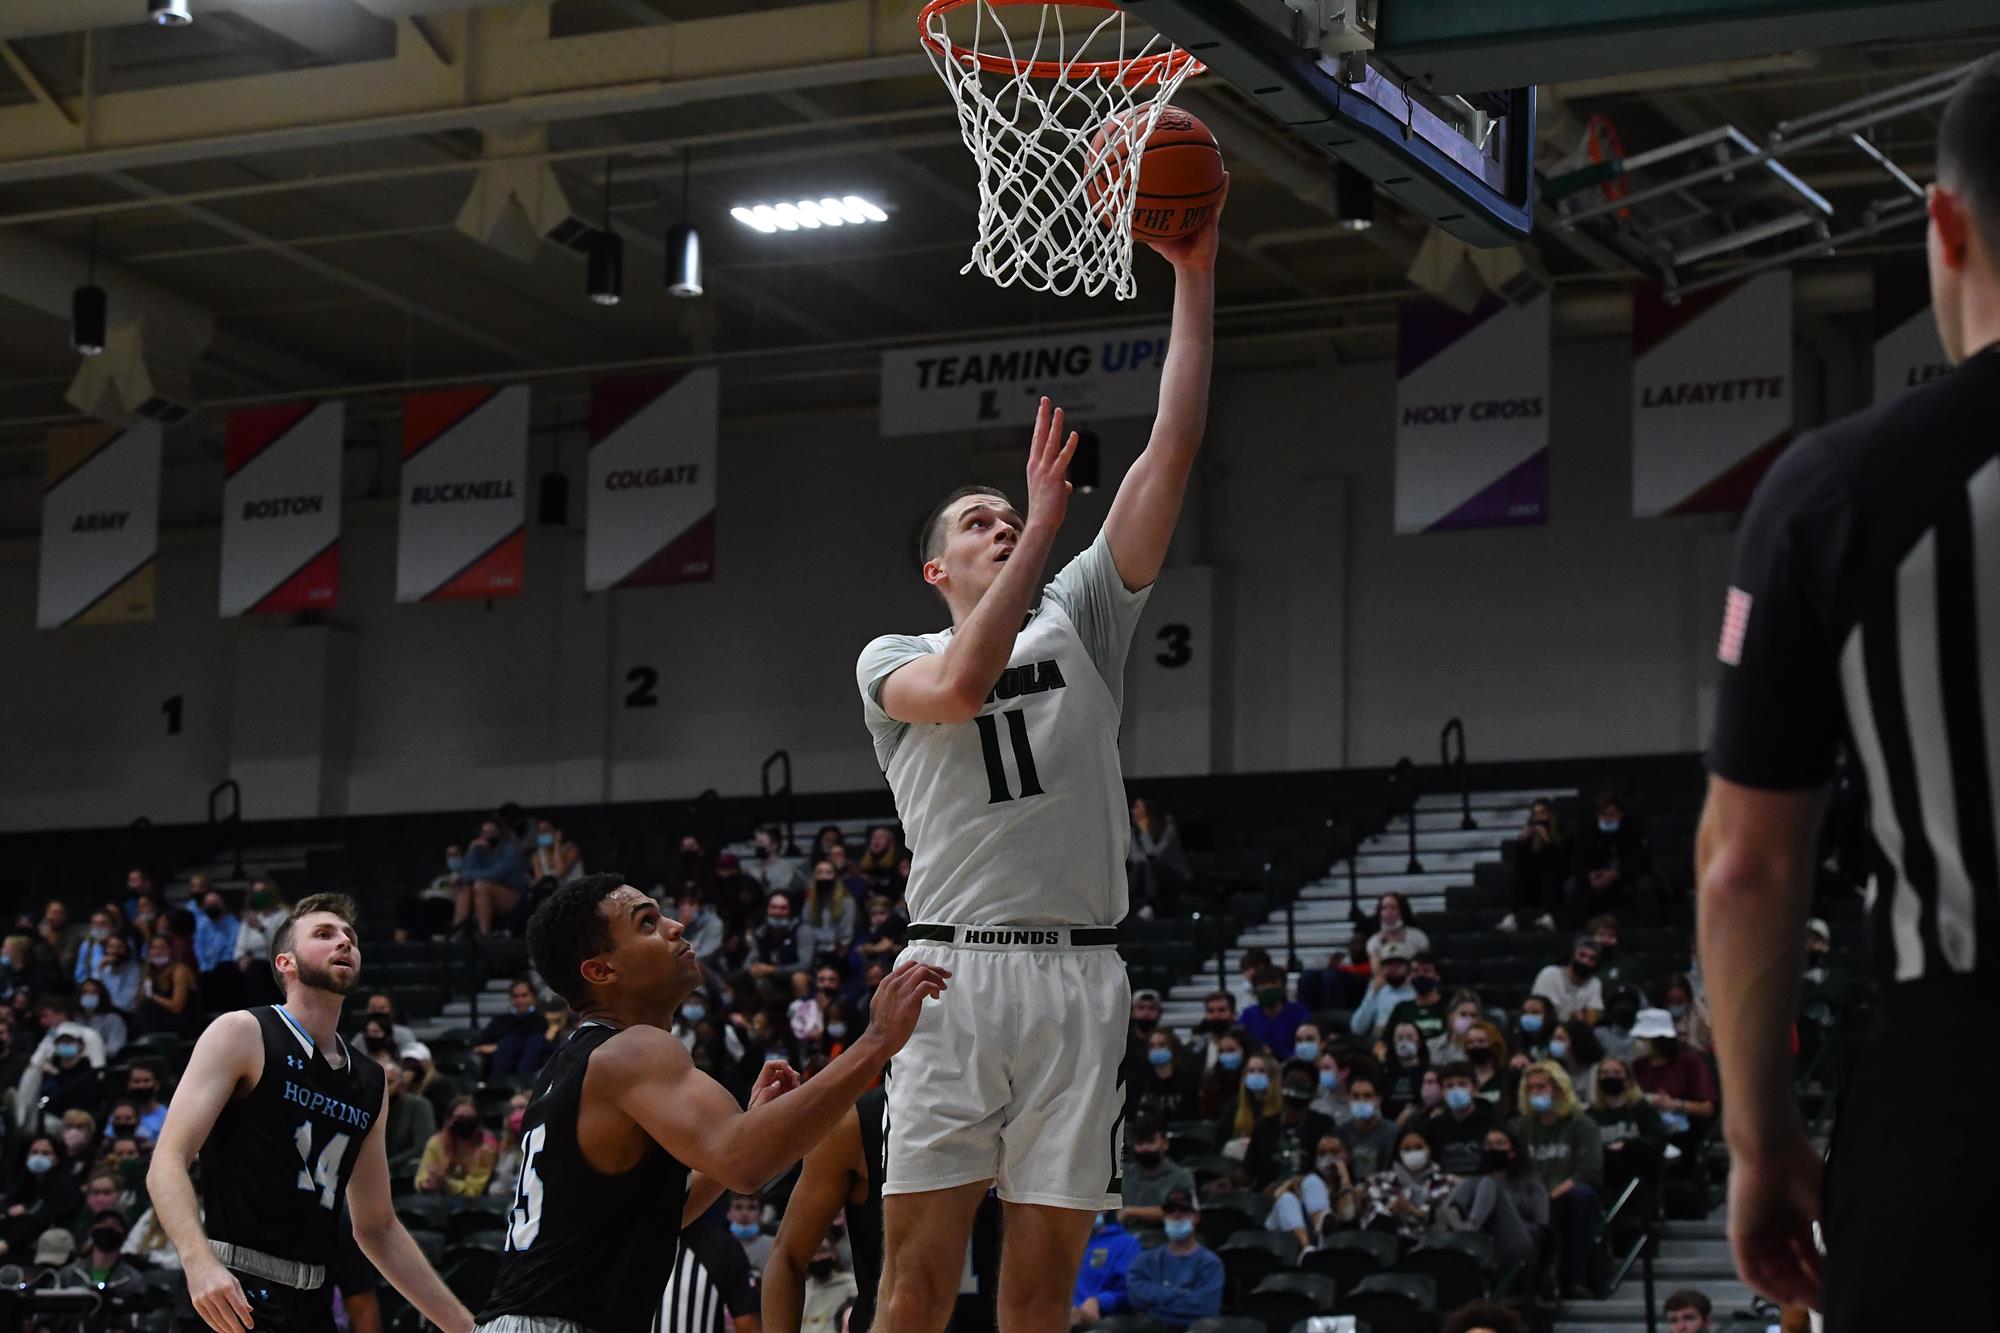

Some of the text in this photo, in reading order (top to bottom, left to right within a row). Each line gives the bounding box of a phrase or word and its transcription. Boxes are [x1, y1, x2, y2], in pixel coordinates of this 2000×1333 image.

[1133, 207, 1175, 231] THE
[917, 346, 1091, 388] TEAMING
[1642, 376, 1783, 407] LAFAYETTE
[1403, 397, 1543, 427] HOLY CROSS
[410, 480, 515, 504] BUCKNELL
[605, 464, 699, 489] COLGATE
[71, 511, 128, 532] ARMY
[242, 496, 322, 520] BOSTON
[1155, 624, 1192, 668] 3
[625, 666, 657, 707] 2
[984, 659, 1066, 704] OLA
[162, 695, 183, 735] 1
[974, 709, 1045, 804] 11
[965, 930, 1058, 945] HOUNDS
[283, 1080, 370, 1131] HOPKINS
[293, 1119, 350, 1211] 14
